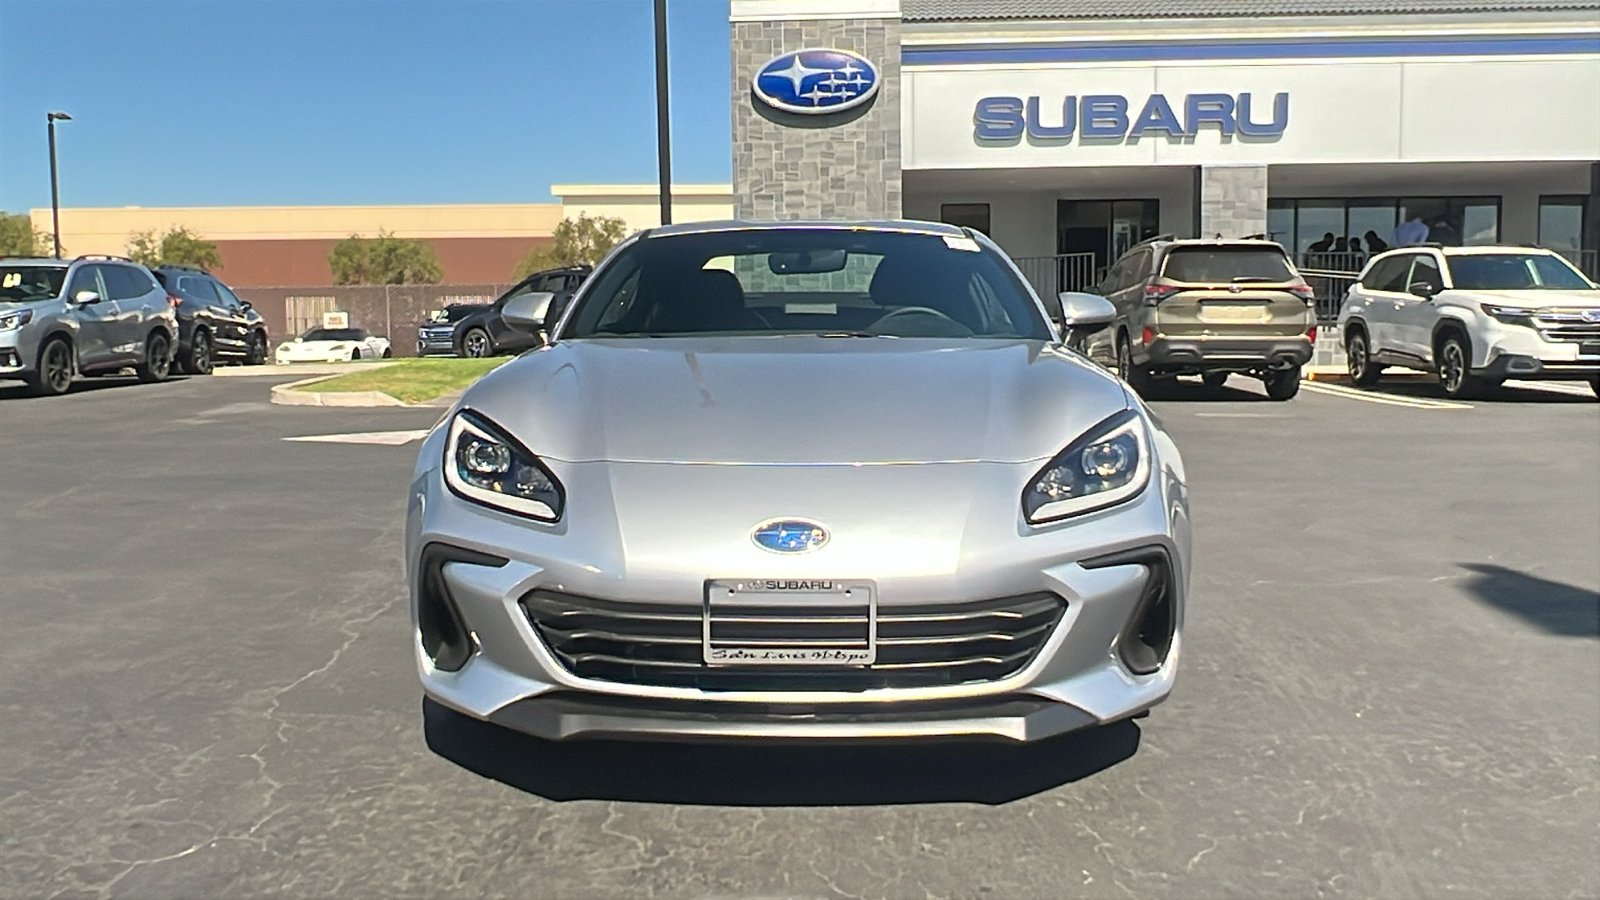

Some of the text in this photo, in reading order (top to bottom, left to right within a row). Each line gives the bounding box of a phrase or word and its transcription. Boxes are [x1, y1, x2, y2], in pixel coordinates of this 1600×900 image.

[974, 92, 1289, 147] SUBARU
[766, 580, 833, 590] SUBARU
[712, 649, 869, 662] San Luis Obispo
